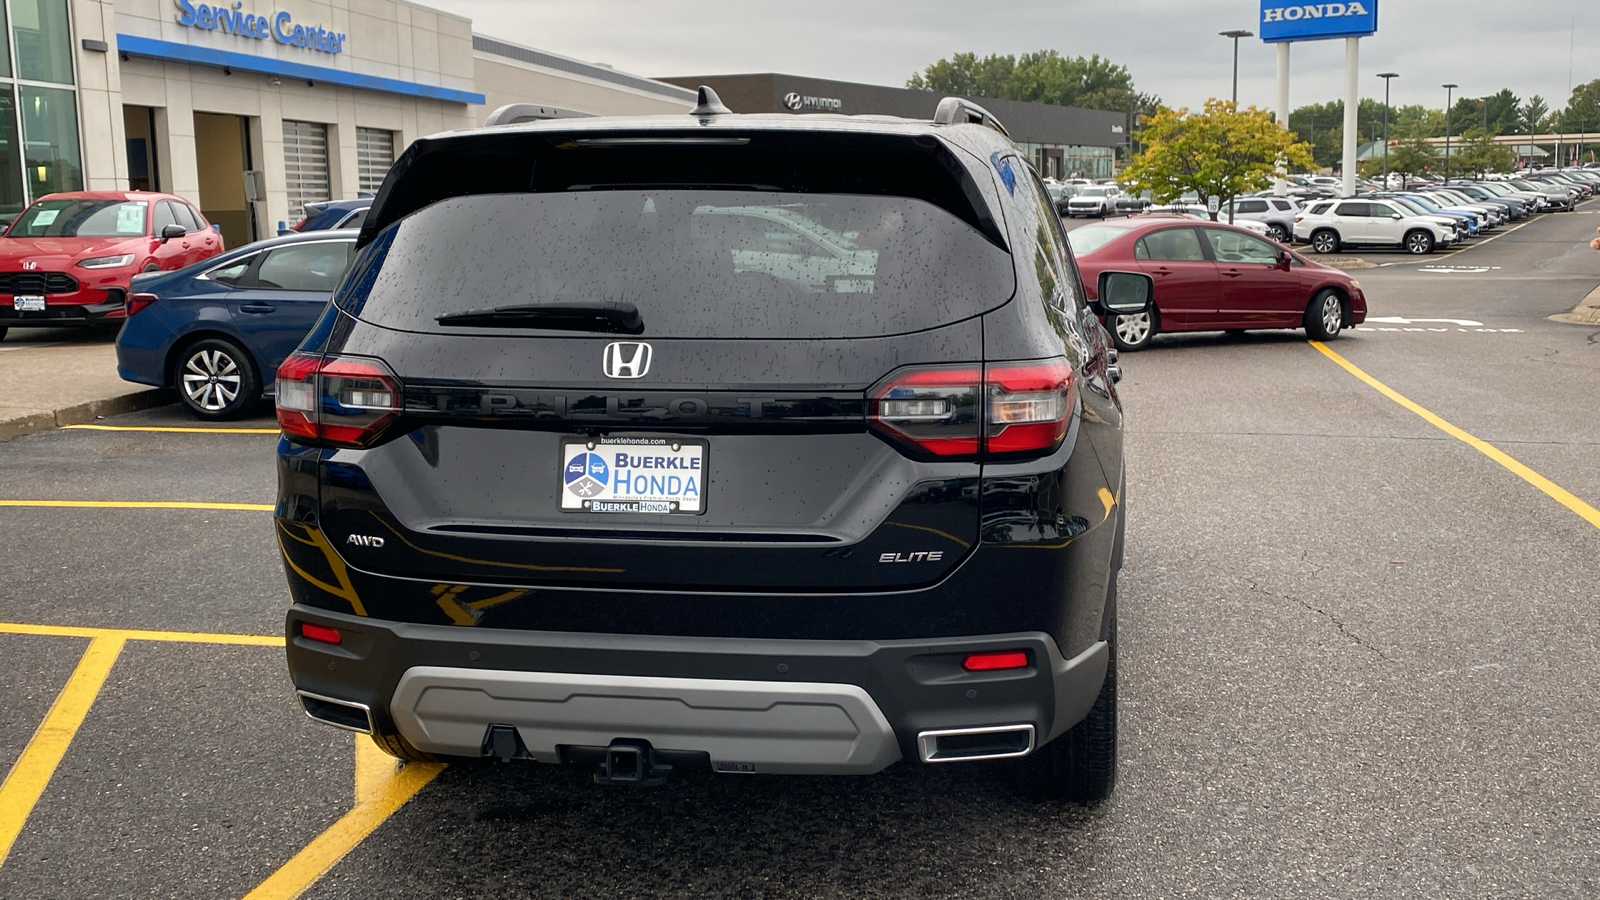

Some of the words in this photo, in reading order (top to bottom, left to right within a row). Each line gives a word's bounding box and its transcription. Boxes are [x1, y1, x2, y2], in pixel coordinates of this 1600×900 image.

[1263, 1, 1369, 23] HONDA
[176, 0, 269, 39] Service
[271, 11, 346, 53] Center
[803, 95, 842, 109] HYUNDAI
[479, 394, 776, 419] PILOT
[600, 437, 666, 445] buerklehonda.com
[614, 452, 701, 470] BUERKLE
[613, 469, 699, 497] HONDA
[346, 533, 385, 548] AWD
[878, 550, 944, 563] ELITE
